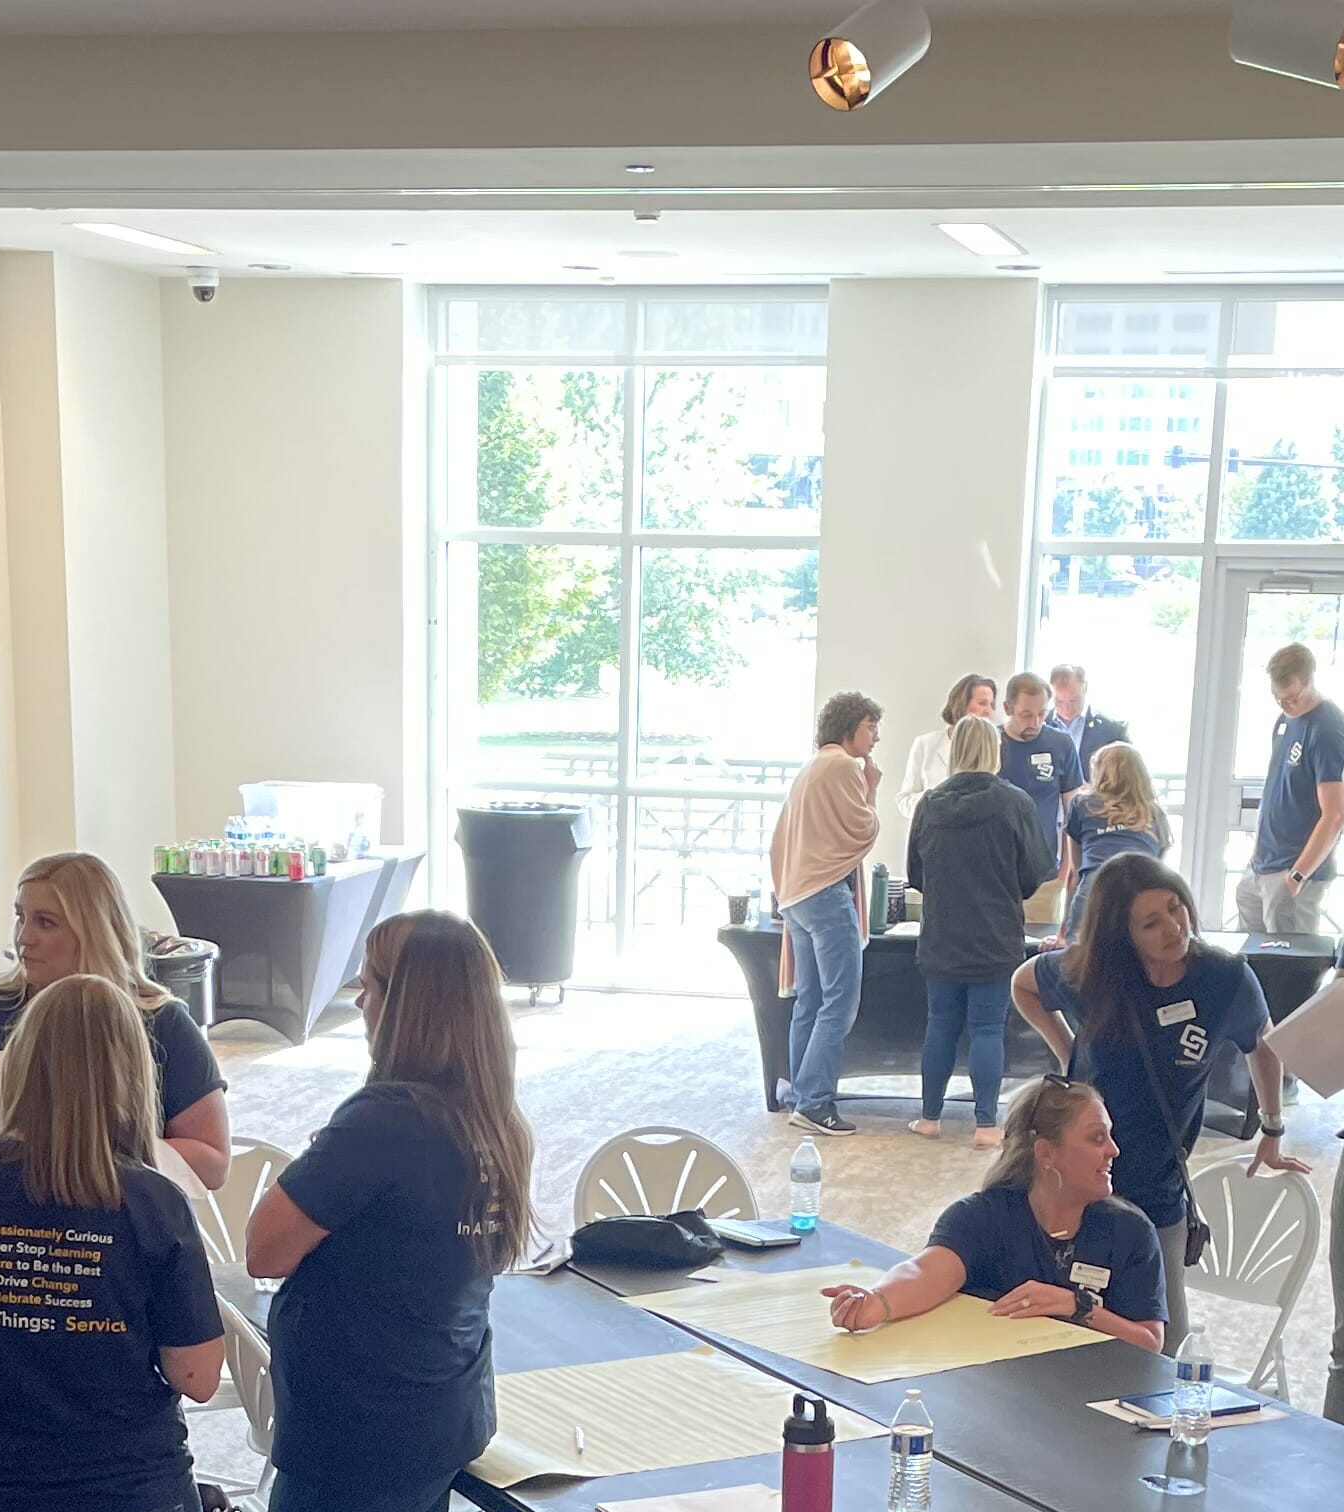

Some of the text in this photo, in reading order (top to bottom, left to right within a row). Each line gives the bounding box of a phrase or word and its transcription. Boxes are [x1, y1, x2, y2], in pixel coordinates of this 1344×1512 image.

[65, 1229, 114, 1245] Curious
[16, 1241, 46, 1258] Stop
[49, 1246, 102, 1263] Learning
[16, 1260, 30, 1271] to
[33, 1260, 50, 1273] Be
[51, 1262, 71, 1275] the
[74, 1264, 102, 1277] Best
[31, 1276, 79, 1293] Change
[44, 1294, 93, 1309] Success
